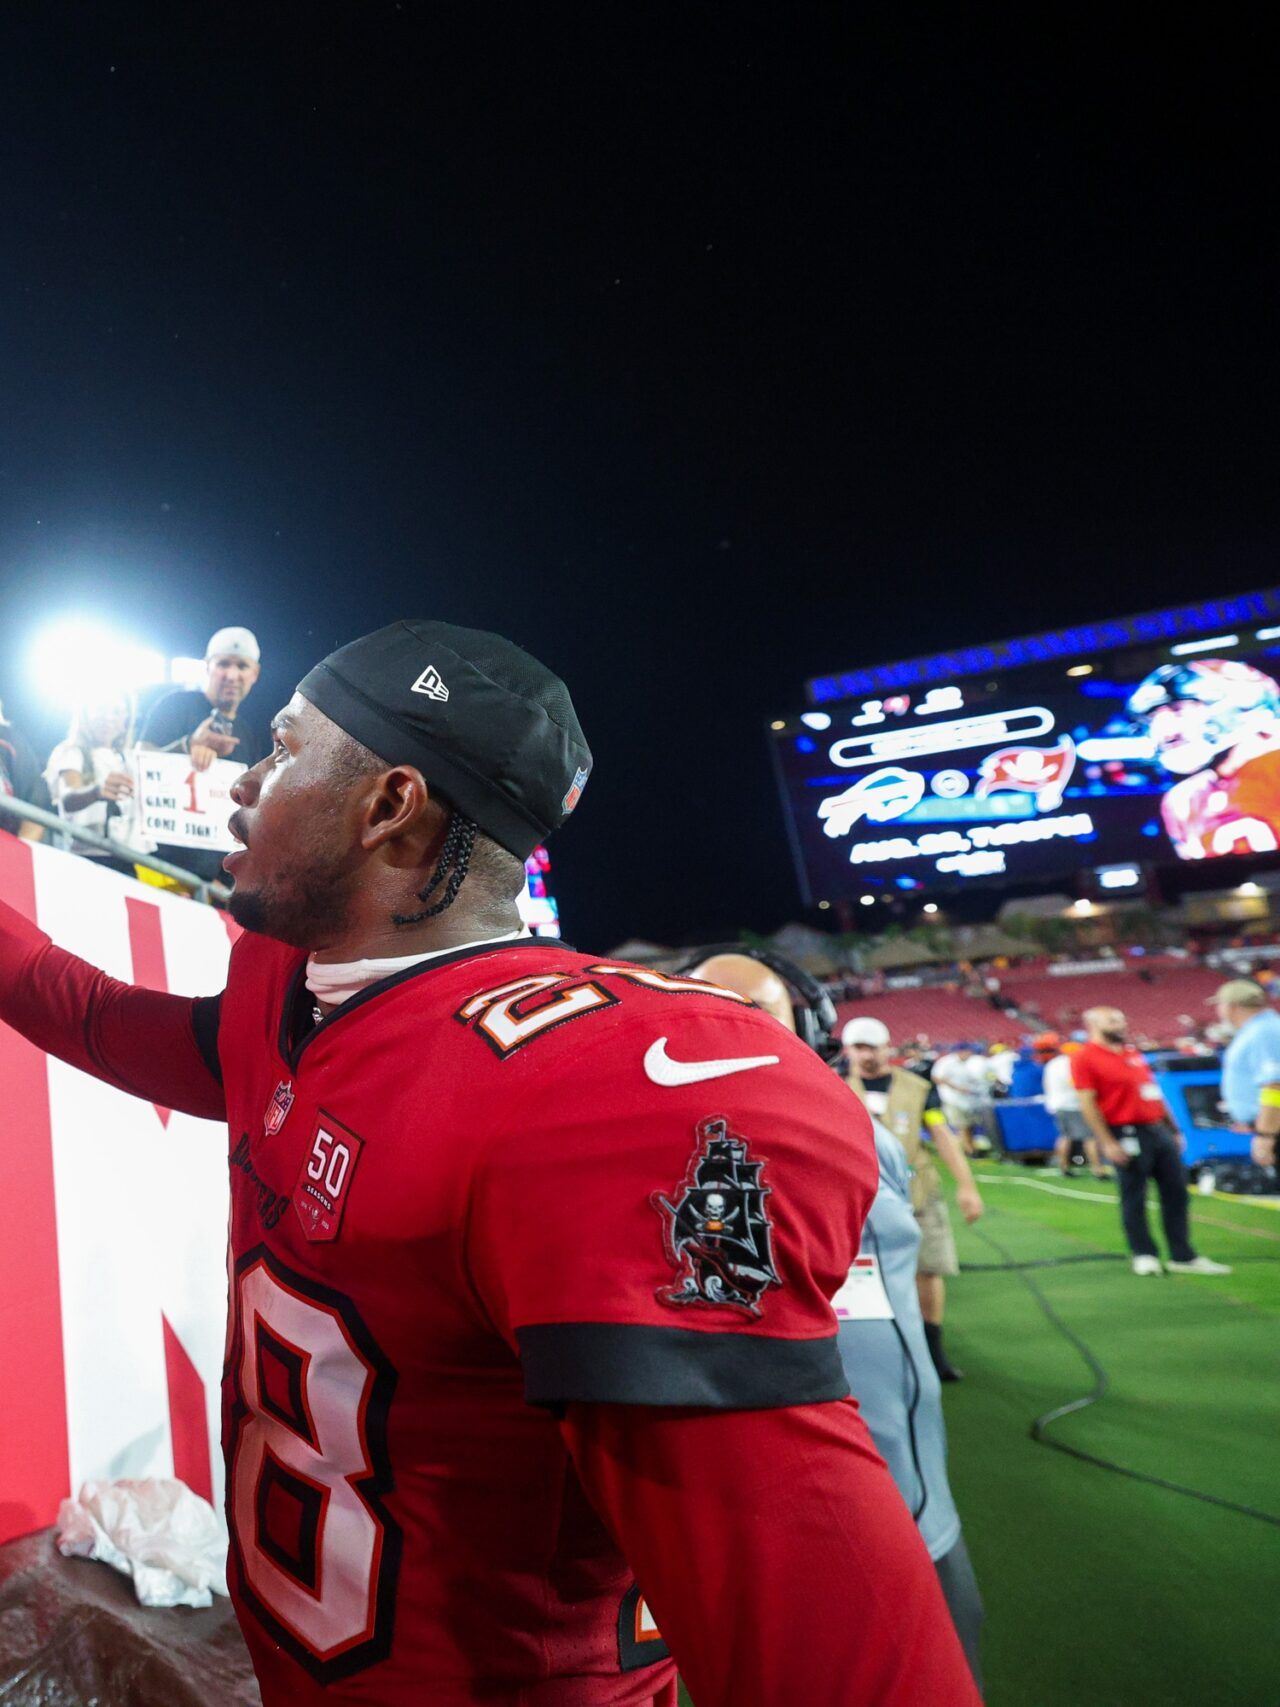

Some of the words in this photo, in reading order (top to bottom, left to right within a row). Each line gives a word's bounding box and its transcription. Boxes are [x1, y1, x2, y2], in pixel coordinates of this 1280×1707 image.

[146, 796, 176, 809] GAME
[183, 770, 206, 814] 1
[147, 816, 176, 832] COME
[307, 1128, 350, 1198] 50
[306, 1185, 332, 1210] SEASONS
[228, 1244, 404, 1684] 8
